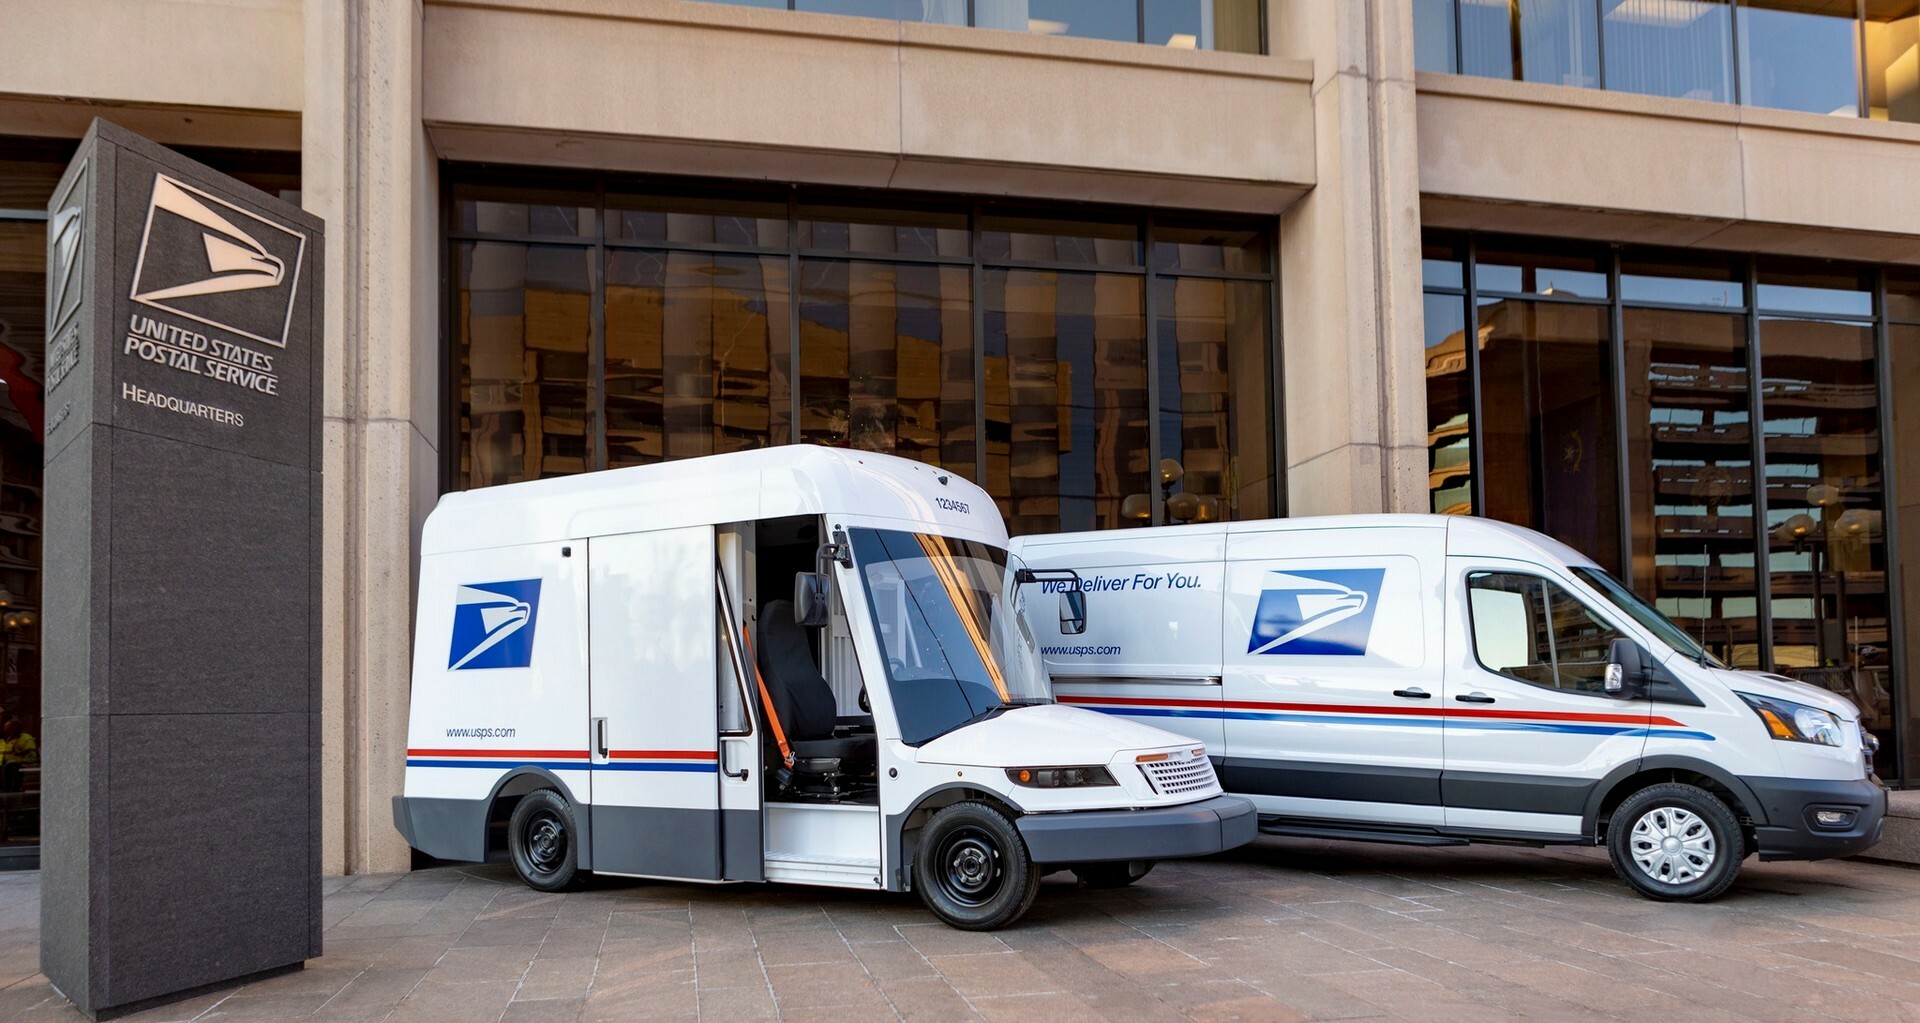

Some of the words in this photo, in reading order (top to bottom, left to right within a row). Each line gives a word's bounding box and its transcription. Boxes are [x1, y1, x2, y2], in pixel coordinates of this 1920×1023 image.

[130, 314, 208, 352] UNITED
[209, 339, 274, 372] STATES
[124, 336, 201, 374] POSTAL
[936, 497, 970, 514] 1234567
[1042, 579, 1066, 594] We
[1070, 575, 1130, 592] Deliver
[1132, 573, 1163, 590] For
[1166, 572, 1202, 589] You.
[1040, 645, 1121, 657] www.usps.com
[446, 728, 516, 740] www.usps.com
